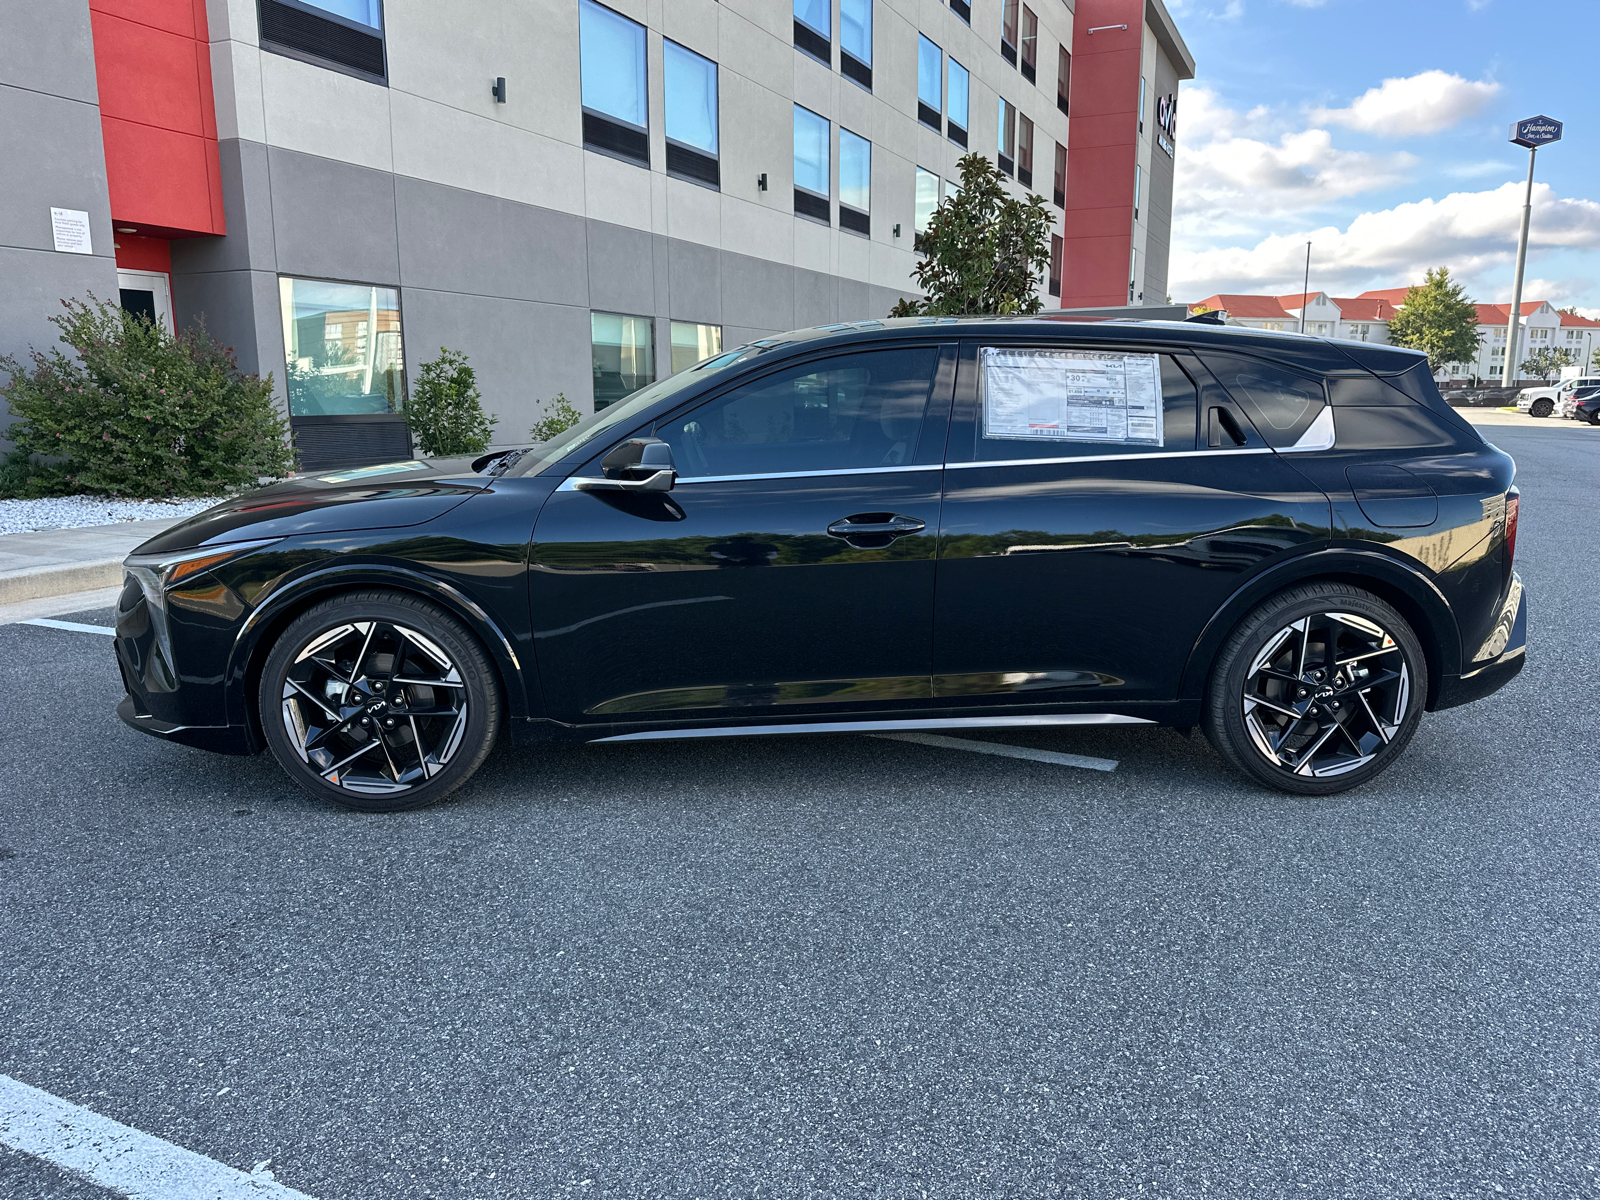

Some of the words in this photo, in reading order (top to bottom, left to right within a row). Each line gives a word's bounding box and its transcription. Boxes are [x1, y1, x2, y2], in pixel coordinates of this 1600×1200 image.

[1157, 94, 1177, 141] avid
[1522, 123, 1557, 133] Hampton
[439, 631, 476, 680] KUMHO
